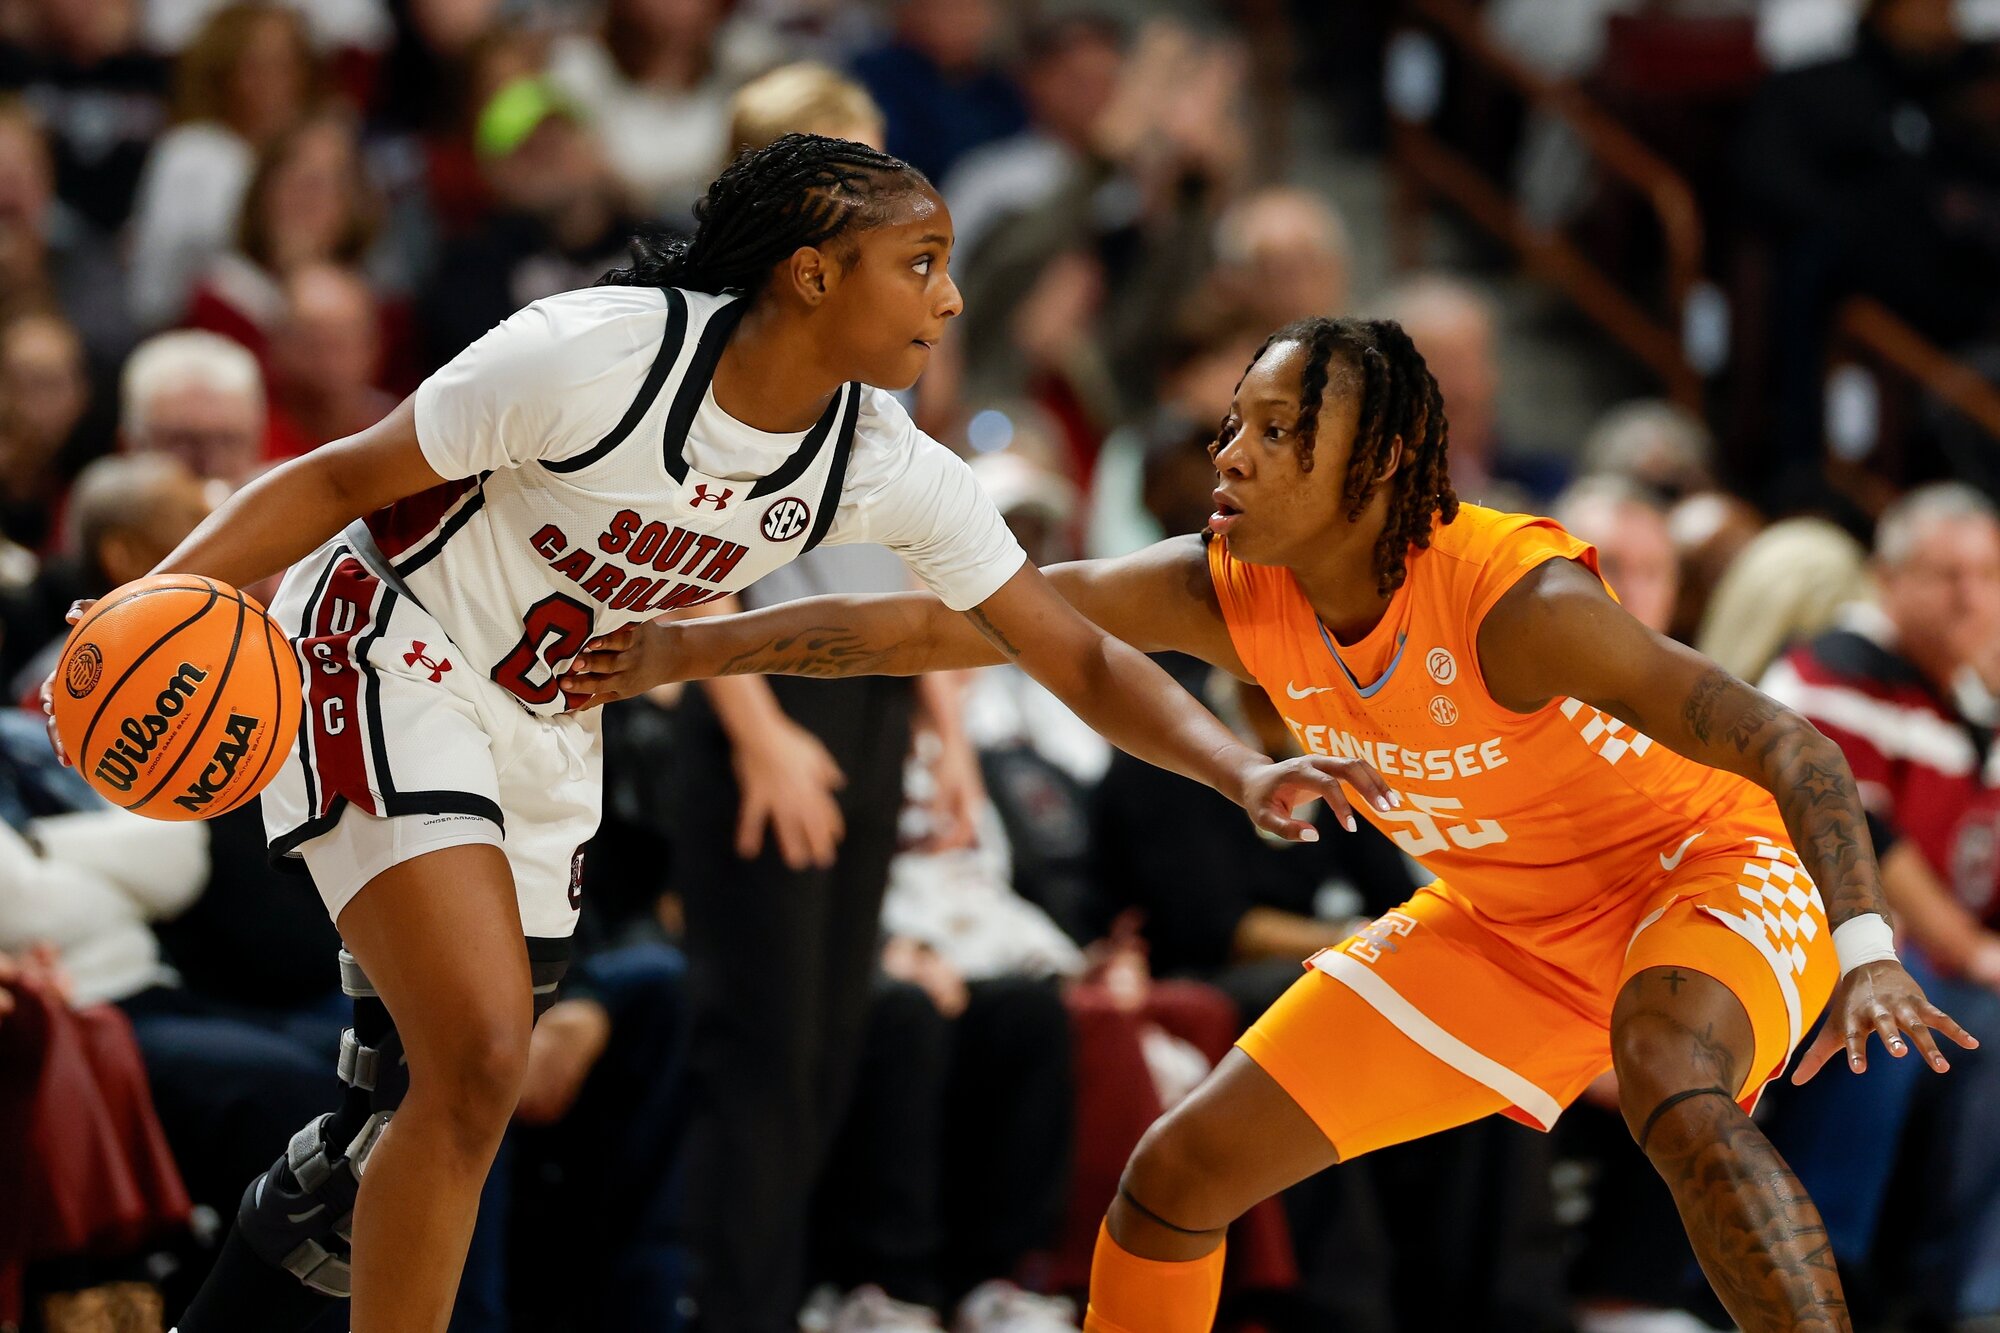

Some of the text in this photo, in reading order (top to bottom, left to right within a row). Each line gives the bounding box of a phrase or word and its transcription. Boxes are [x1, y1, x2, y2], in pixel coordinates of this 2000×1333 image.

[598, 508, 750, 584] SOUTH
[764, 500, 807, 540] SEC
[94, 661, 208, 792] Wilson
[1430, 696, 1456, 724] SEC
[173, 713, 259, 812] NCAA
[1284, 716, 1509, 781] TENNESSEE
[423, 816, 452, 826] UNDER
